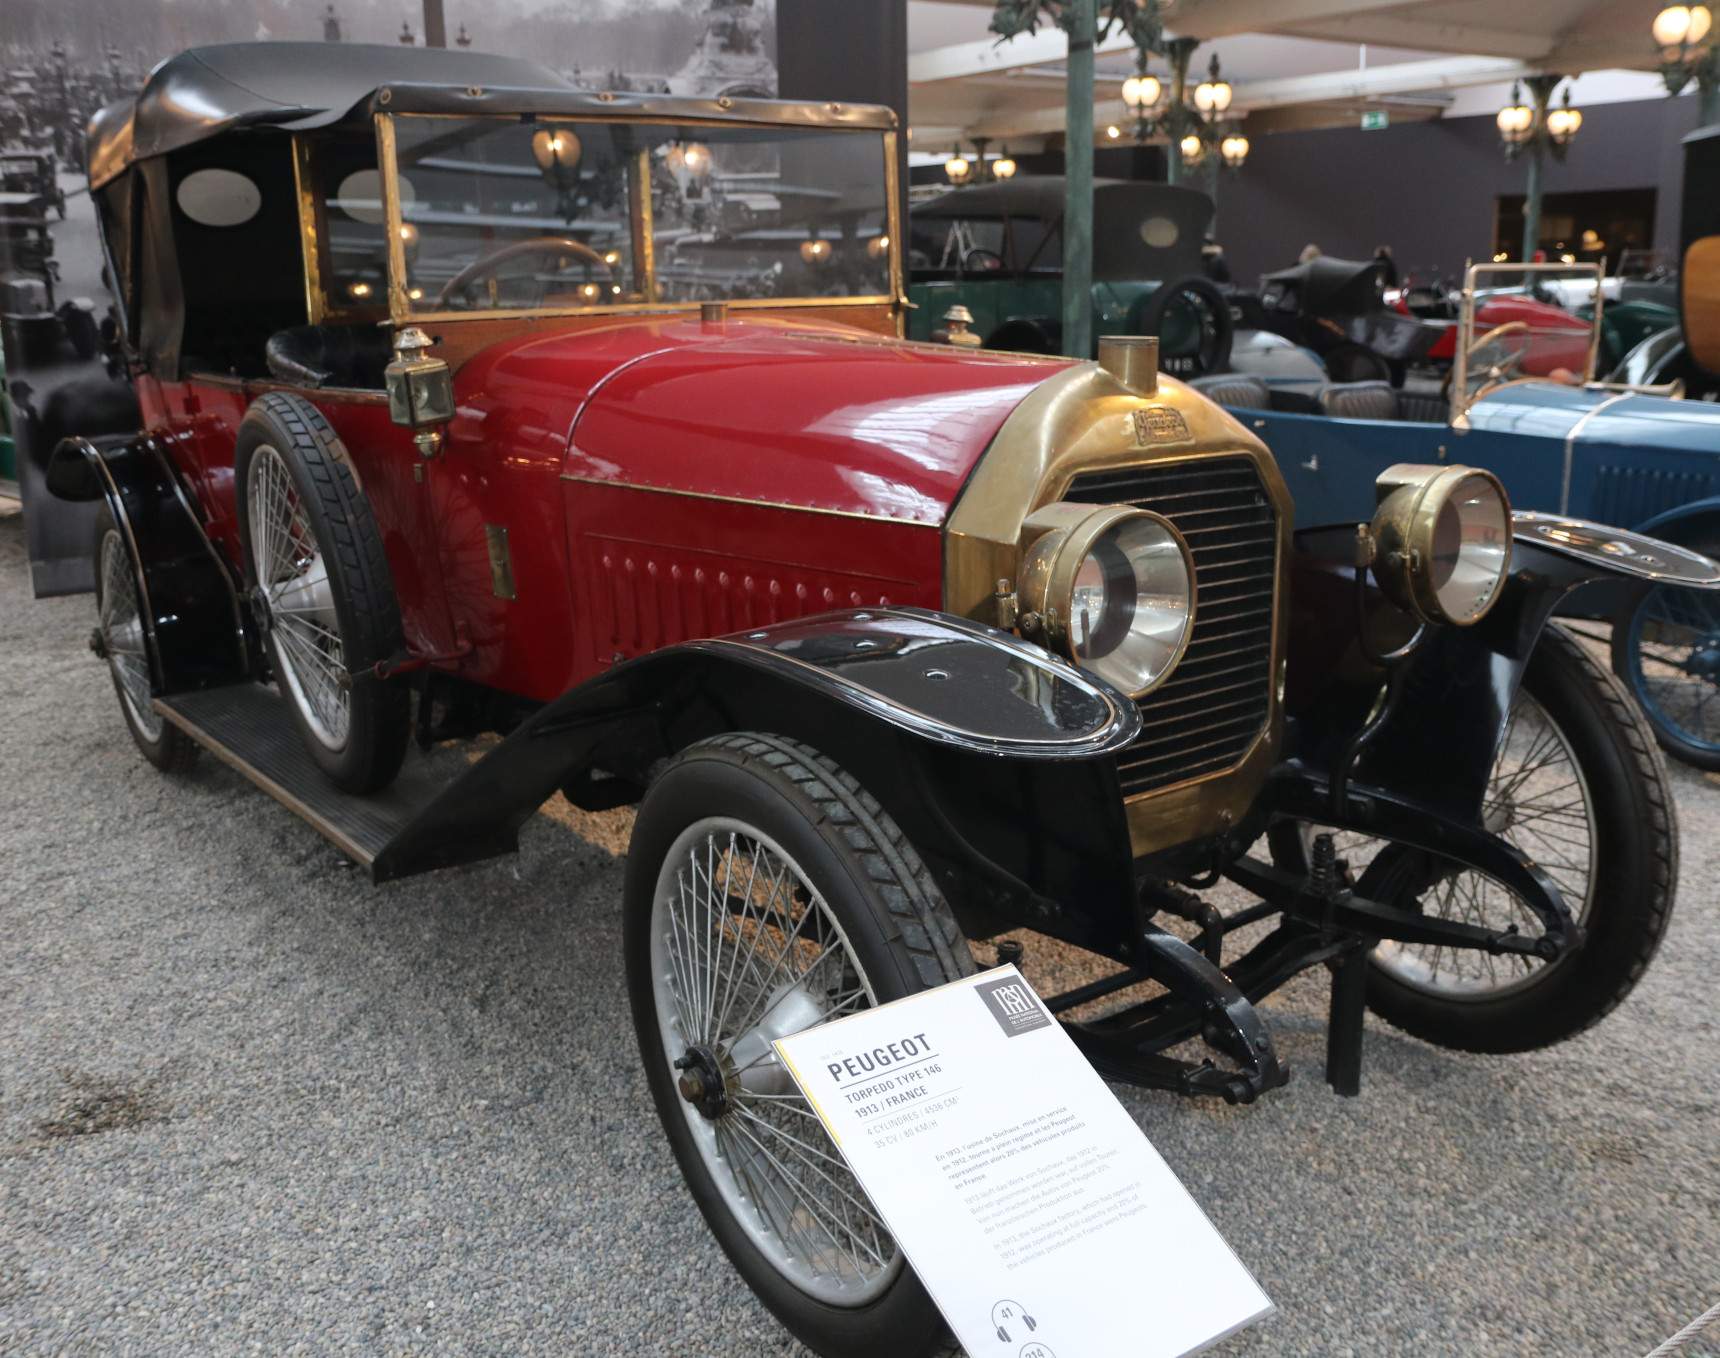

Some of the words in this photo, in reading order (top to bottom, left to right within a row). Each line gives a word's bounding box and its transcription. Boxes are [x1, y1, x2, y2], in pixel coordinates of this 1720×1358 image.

[827, 1033, 931, 1082] PEUGEOT
[845, 1080, 895, 1104] TORPEDO
[894, 1070, 923, 1086] TYPE
[924, 1063, 942, 1076] 146
[855, 1102, 879, 1118] 1913
[880, 1101, 885, 1110] /
[885, 1085, 928, 1107] FRANCE
[866, 1127, 873, 1136] 4
[873, 1111, 919, 1133] CYLINDRES
[874, 1138, 886, 1148] 35
[915, 1119, 939, 1134] KM/H
[1050, 1114, 1076, 1129] Peugeot
[1001, 1307, 1013, 1319] 41
